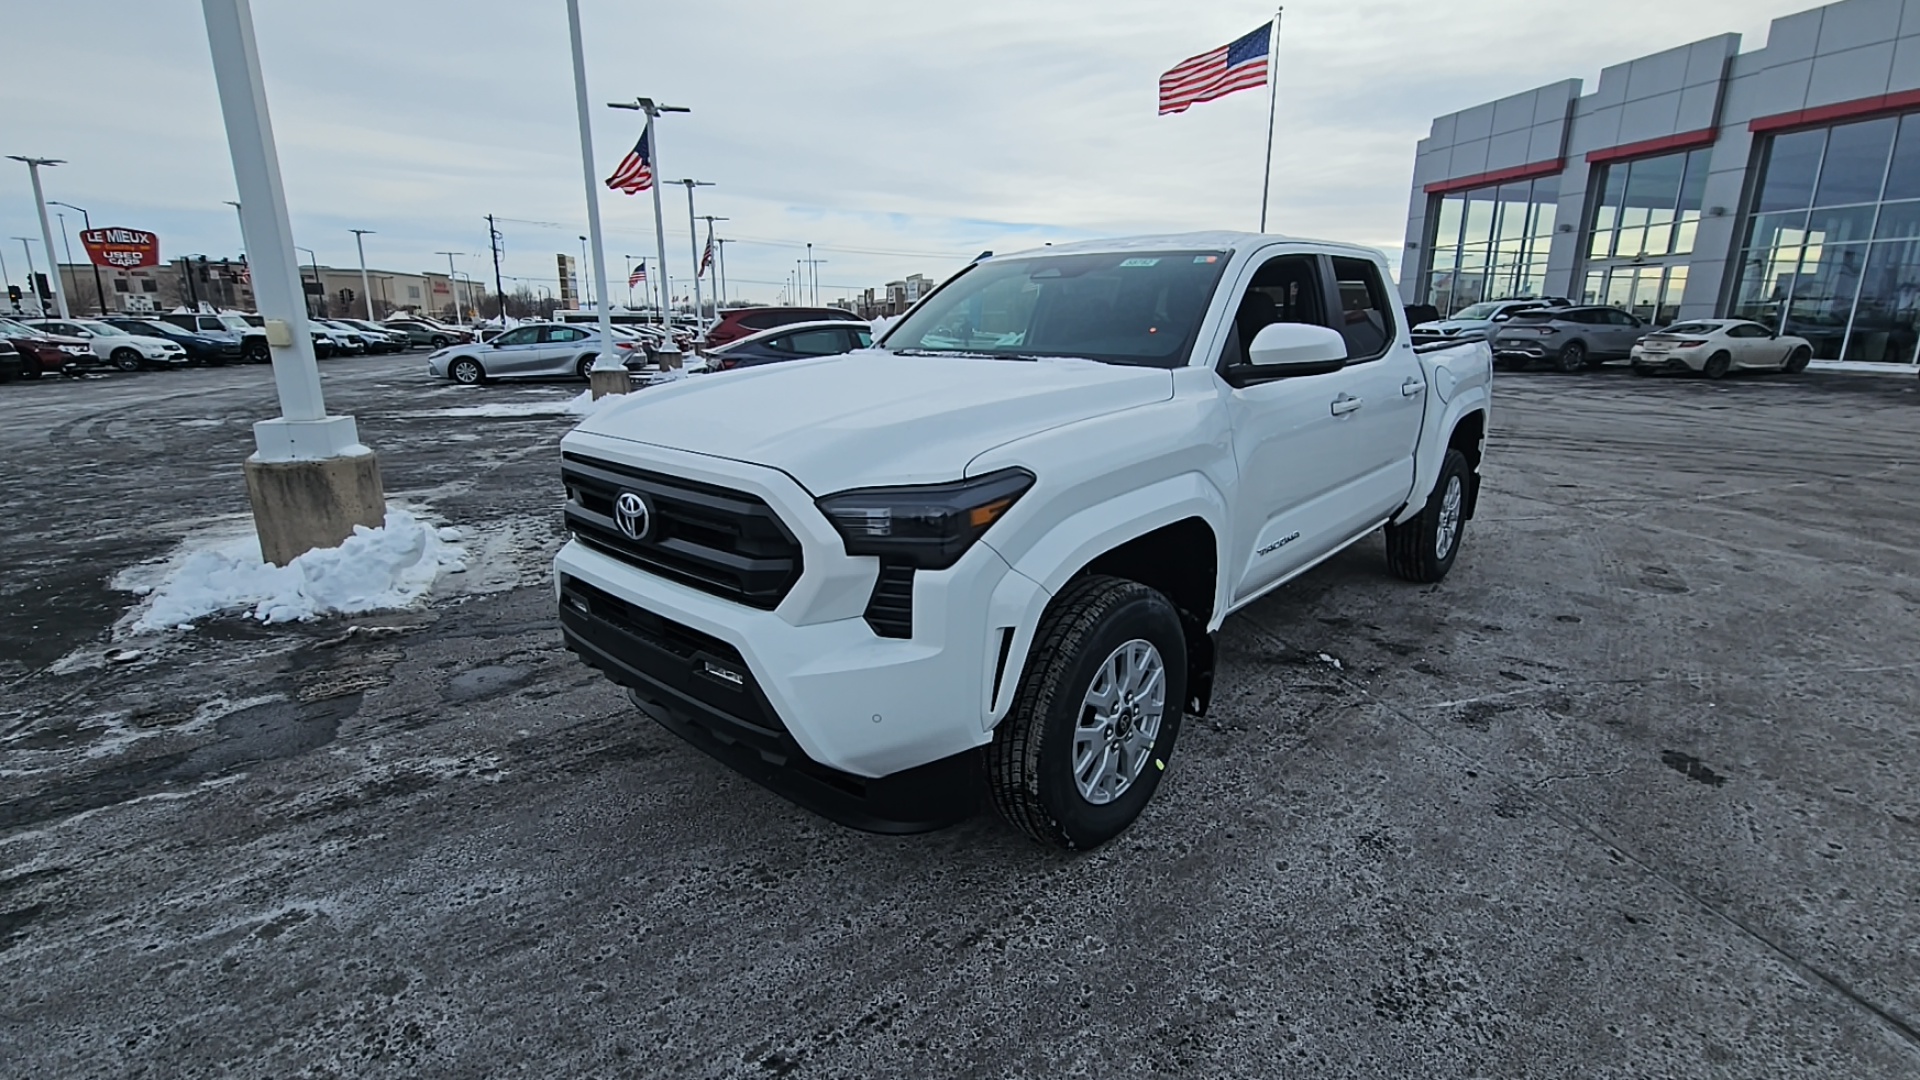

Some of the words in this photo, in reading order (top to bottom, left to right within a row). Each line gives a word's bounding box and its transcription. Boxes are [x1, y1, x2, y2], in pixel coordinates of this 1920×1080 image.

[86, 231, 103, 242] LE
[106, 230, 150, 243] MIEUX
[103, 251, 143, 259] USED
[1256, 530, 1300, 556] TACOMA
